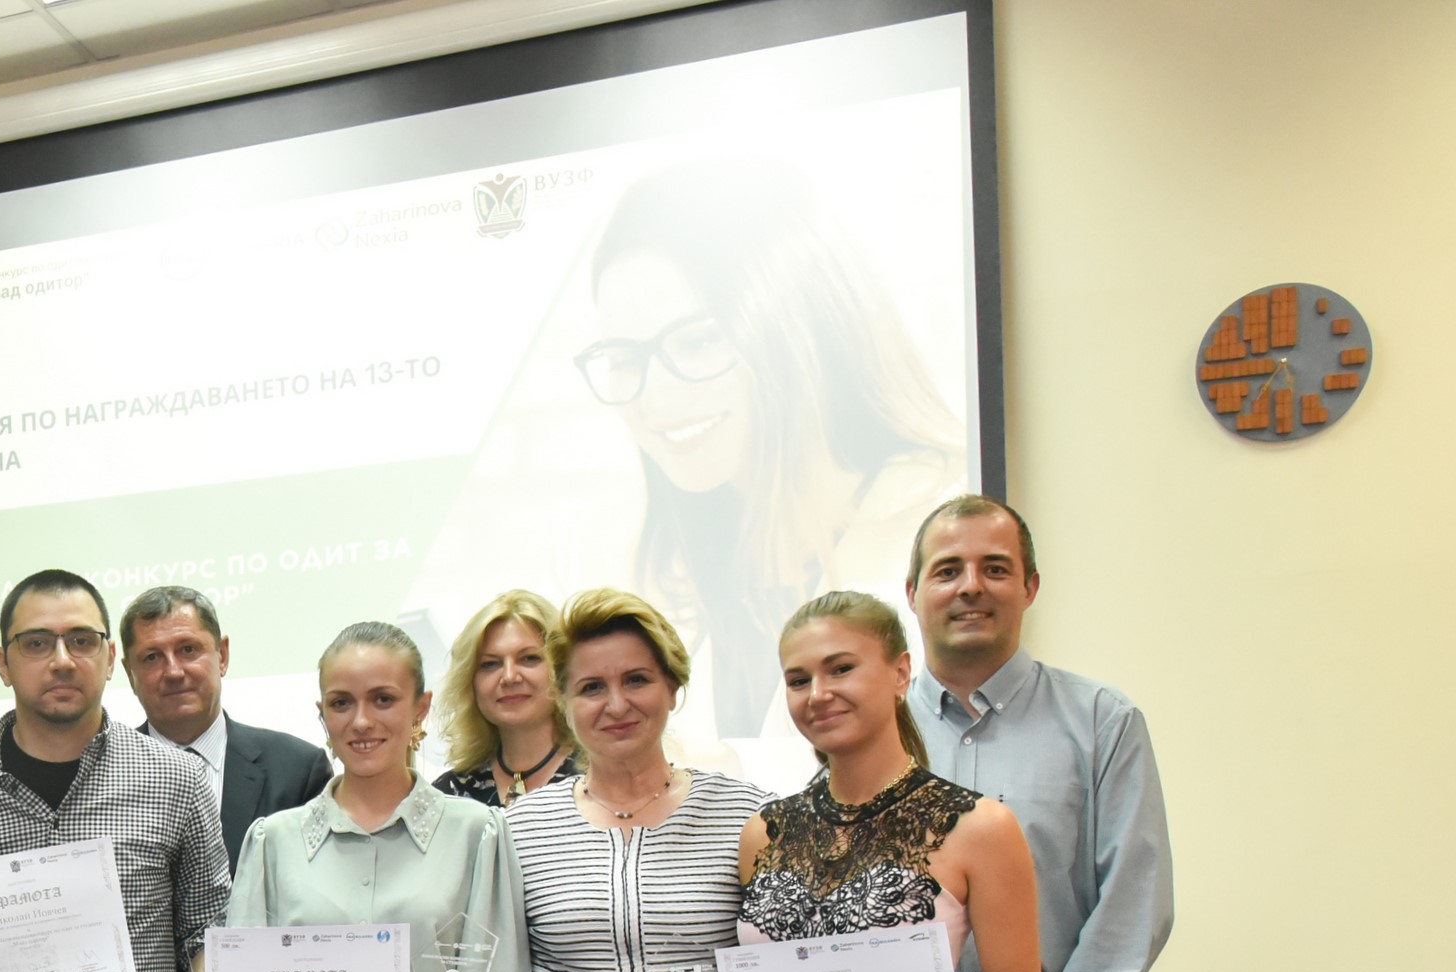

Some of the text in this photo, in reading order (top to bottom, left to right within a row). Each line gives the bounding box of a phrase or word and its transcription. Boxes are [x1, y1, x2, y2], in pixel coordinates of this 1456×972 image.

[534, 168, 593, 191] ВУЗФ
[355, 200, 462, 228] Zaharinova
[355, 227, 409, 248] Nexia
[21, 408, 57, 433] ПО
[64, 373, 311, 425] НАГРАЖДАВАНЕТО
[319, 366, 357, 391] НА
[365, 355, 442, 384] 13-ТО
[87, 558, 217, 590] КОНКУРС
[227, 553, 268, 576] ПО
[278, 542, 364, 572] ОДИТ
[373, 536, 413, 561] ЗА
